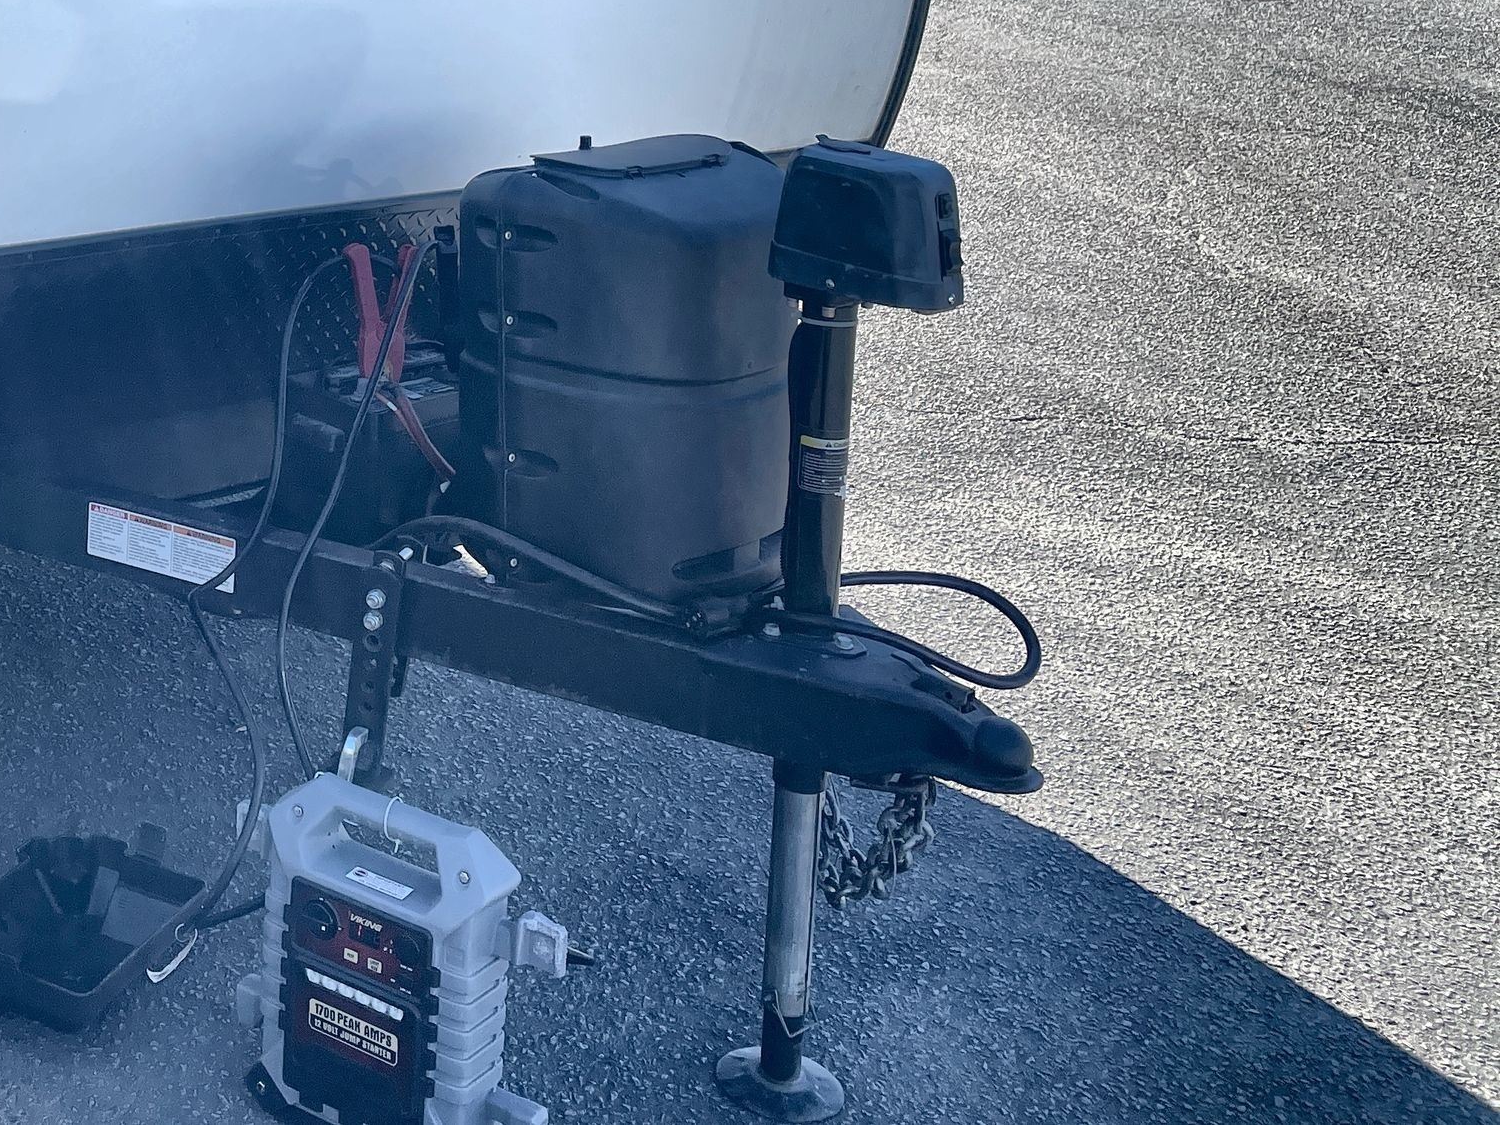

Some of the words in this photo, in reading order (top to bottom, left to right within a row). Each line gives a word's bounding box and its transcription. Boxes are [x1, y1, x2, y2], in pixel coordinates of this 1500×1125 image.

[350, 913, 383, 933] VIKING
[314, 1018, 322, 1029] 12
[322, 1021, 339, 1036] VOLT
[340, 1030, 361, 1046] JUMP
[362, 1039, 392, 1060] STARTER
[315, 1003, 336, 1022] 1700
[337, 1012, 361, 1034] PEAK
[364, 1024, 392, 1048] AMPS
